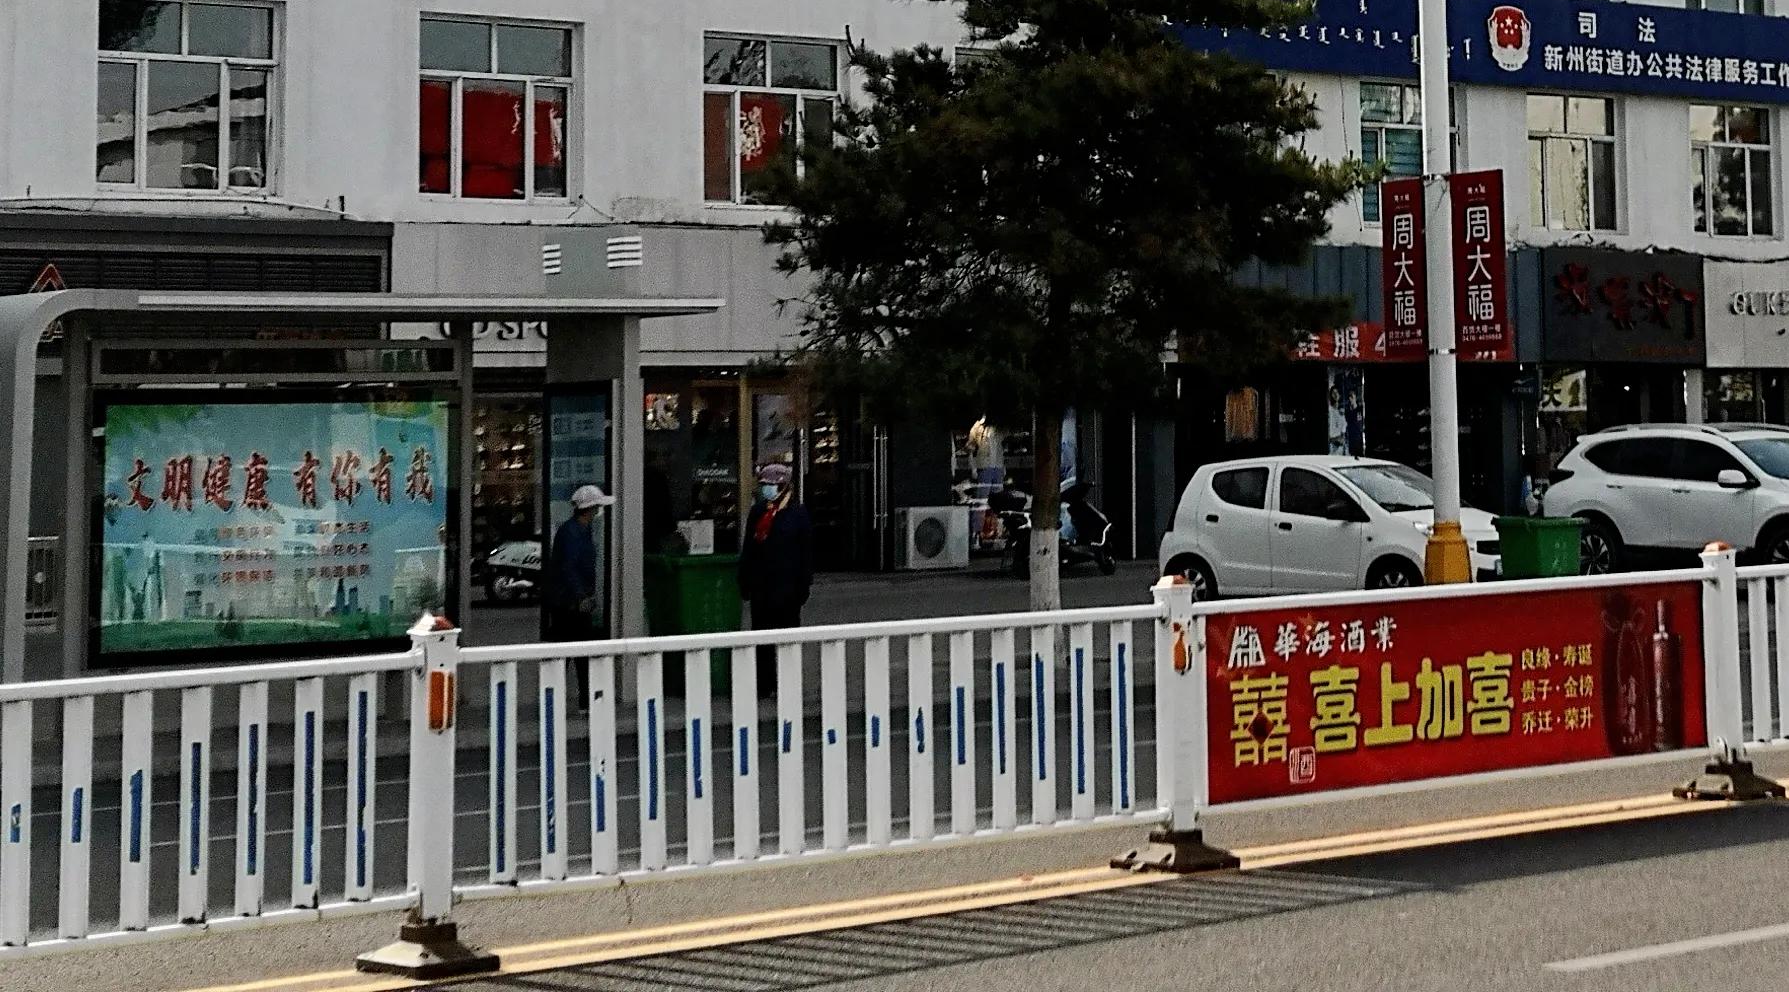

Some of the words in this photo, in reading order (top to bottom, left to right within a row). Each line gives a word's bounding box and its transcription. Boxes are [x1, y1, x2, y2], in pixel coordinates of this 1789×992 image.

[1578, 11, 1656, 44] 司法
[1392, 213, 1417, 326] 周大福
[1466, 206, 1494, 321] 周大福
[127, 451, 274, 512] 文明健康
[291, 446, 435, 508] 有你有我
